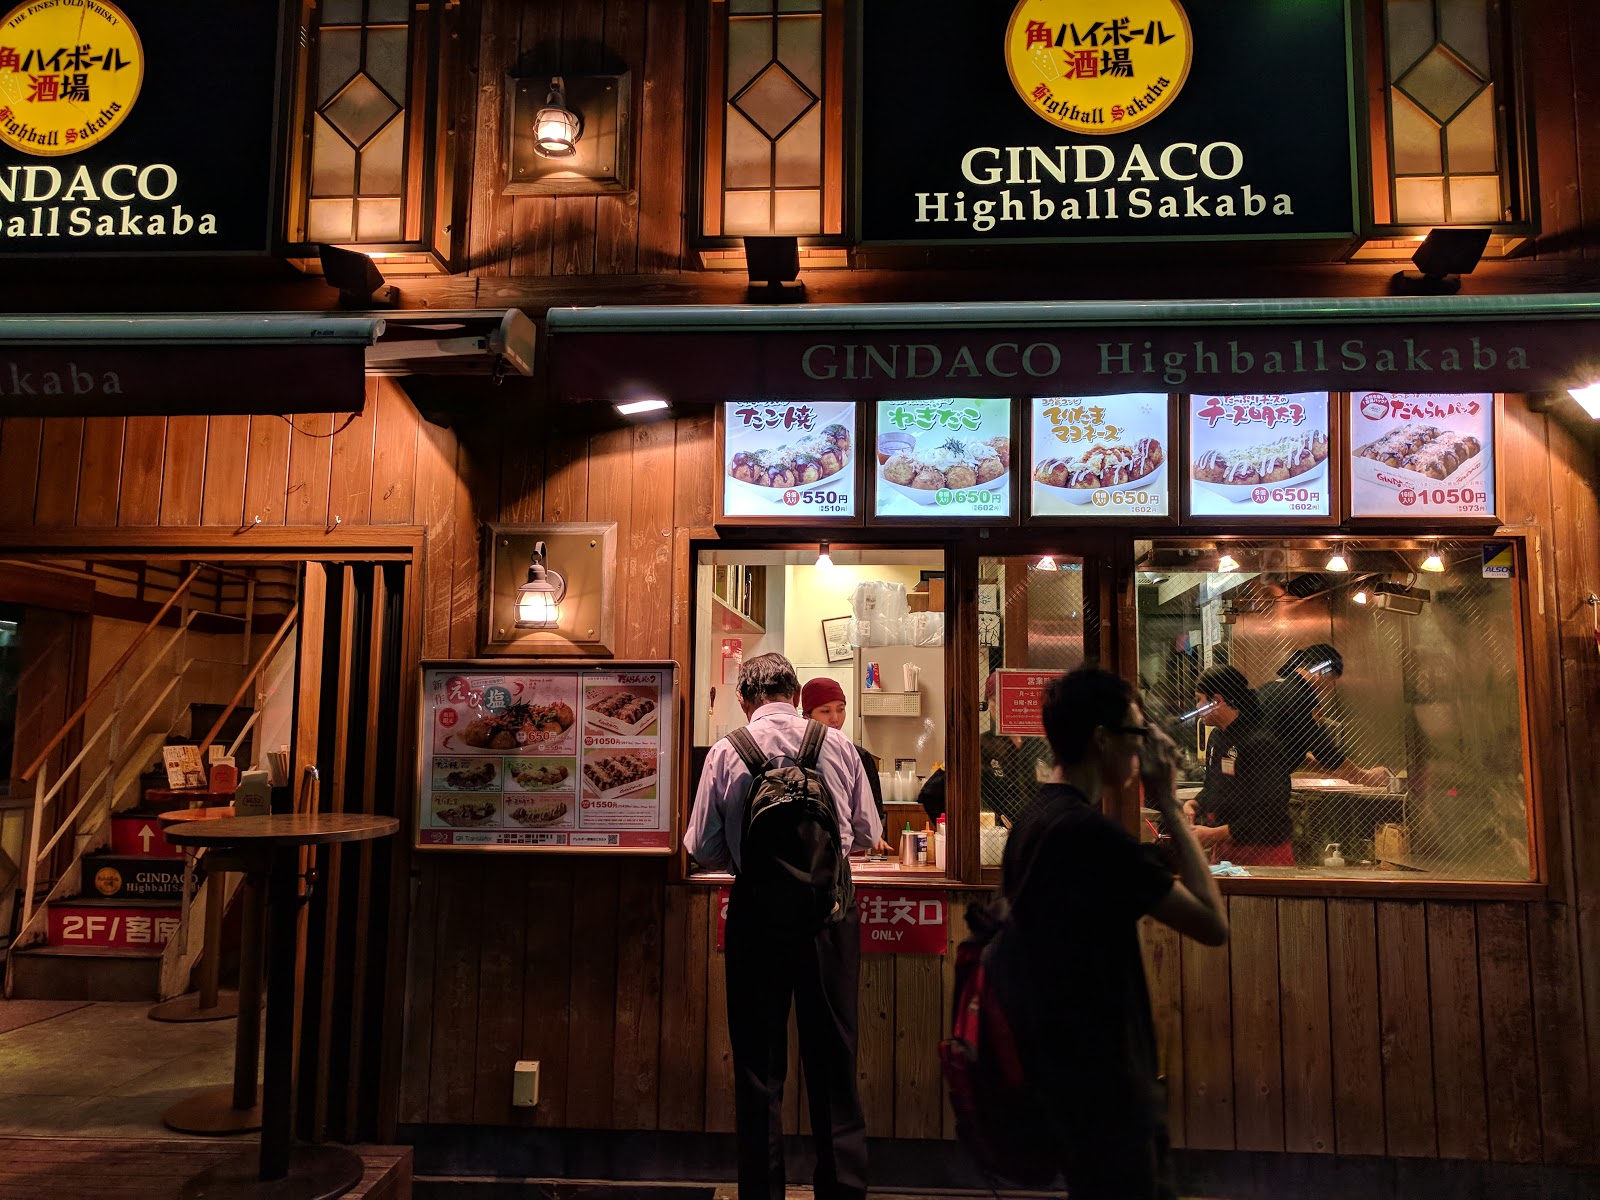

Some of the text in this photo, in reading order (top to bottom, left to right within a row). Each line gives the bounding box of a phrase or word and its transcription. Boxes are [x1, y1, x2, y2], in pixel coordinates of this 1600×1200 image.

[7, 13, 27, 29] THE
[27, 0, 61, 15] FINEST
[86, 0, 119, 26] WHISKY
[1025, 16, 1175, 50] 角ハイボール
[0, 44, 131, 73] 角ハイボール
[1064, 48, 1134, 79] 酒場
[26, 73, 90, 102] 酒場
[1031, 76, 1170, 125] Highball Sakaba
[65, 101, 122, 144] Sakaba
[961, 141, 1244, 185] GINDACO
[801, 342, 1061, 380] GINDACO
[0, 362, 123, 395] kaba
[888, 404, 981, 430] ねぎだこ
[1043, 405, 1105, 425] てりたま
[1198, 398, 1305, 427] チーズ明太子
[1390, 400, 1480, 420] だんらんパック
[1051, 424, 1124, 442] マヨネーズ
[802, 490, 848, 504] 550円
[955, 490, 1001, 504] 650円
[1112, 491, 1159, 505] 650円
[1271, 488, 1320, 502] 650円
[1418, 488, 1487, 505] 1050円
[860, 895, 943, 925] 注文口
[871, 930, 904, 941] ONLY
